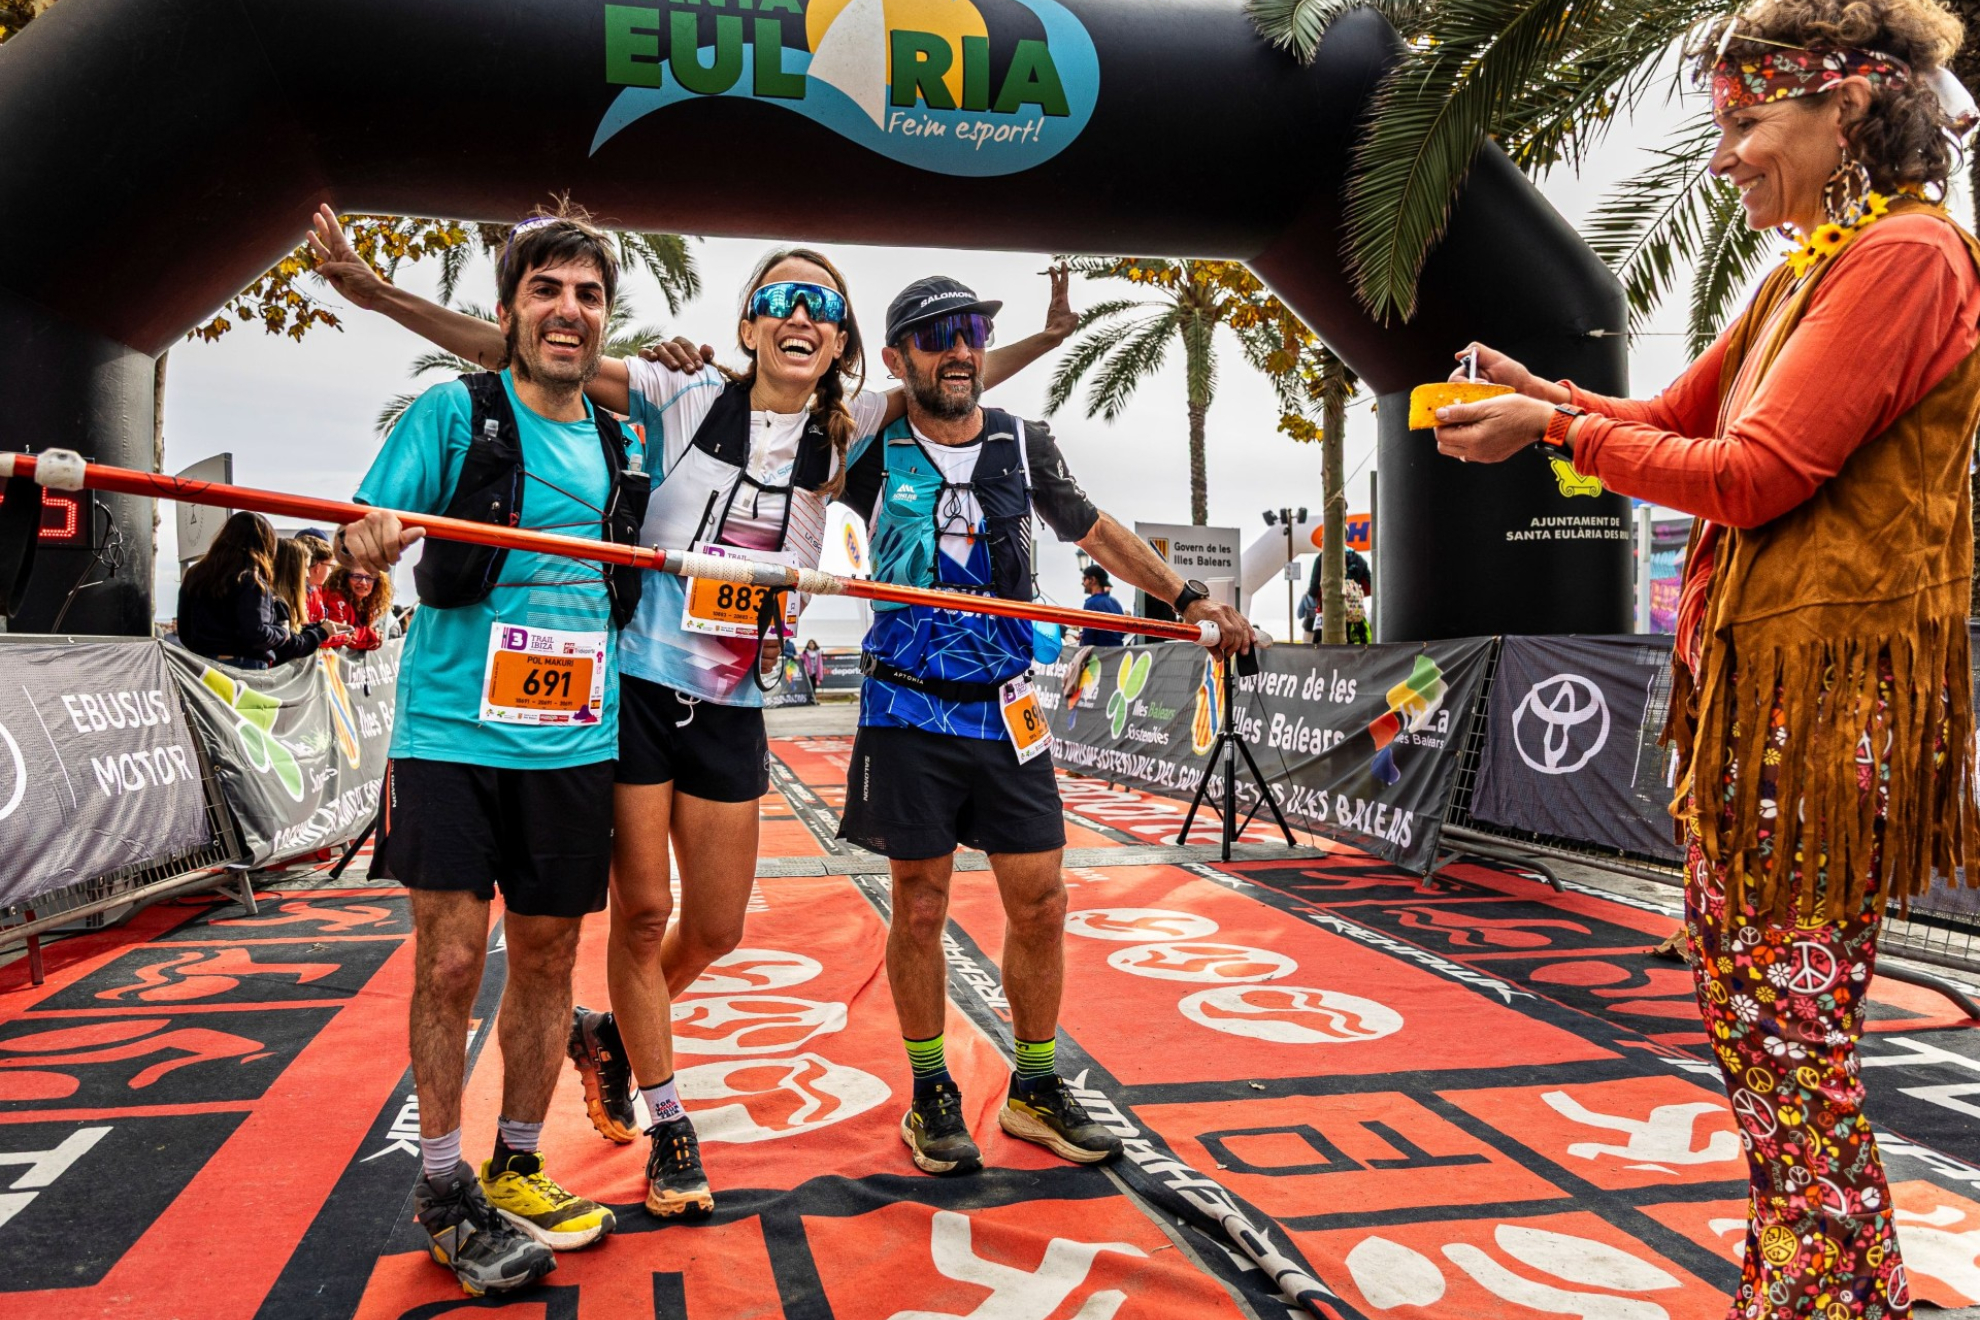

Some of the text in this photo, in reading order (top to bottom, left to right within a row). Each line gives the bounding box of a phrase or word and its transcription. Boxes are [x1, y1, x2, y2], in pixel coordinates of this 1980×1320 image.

[889, 111, 1045, 151] Feim esport!
[920, 291, 974, 308] SALOMON
[1530, 517, 1620, 527] AJUNTAMENT DE
[1506, 531, 1551, 541] SANTA
[1554, 527, 1602, 539] EULÀRIA
[1604, 530, 1618, 539] DES
[1174, 541, 1231, 554] Govern de les
[1174, 554, 1232, 567] Illes Balears
[530, 641, 554, 650] IBIZA
[531, 634, 555, 643] TRAIL
[527, 656, 574, 667] POL MAKURI
[523, 669, 571, 697] 691
[893, 671, 924, 685] APTONIA
[1302, 668, 1325, 702] de
[1329, 669, 1357, 704] les
[61, 690, 171, 733] EBUSUS
[91, 745, 194, 797] MOTOR
